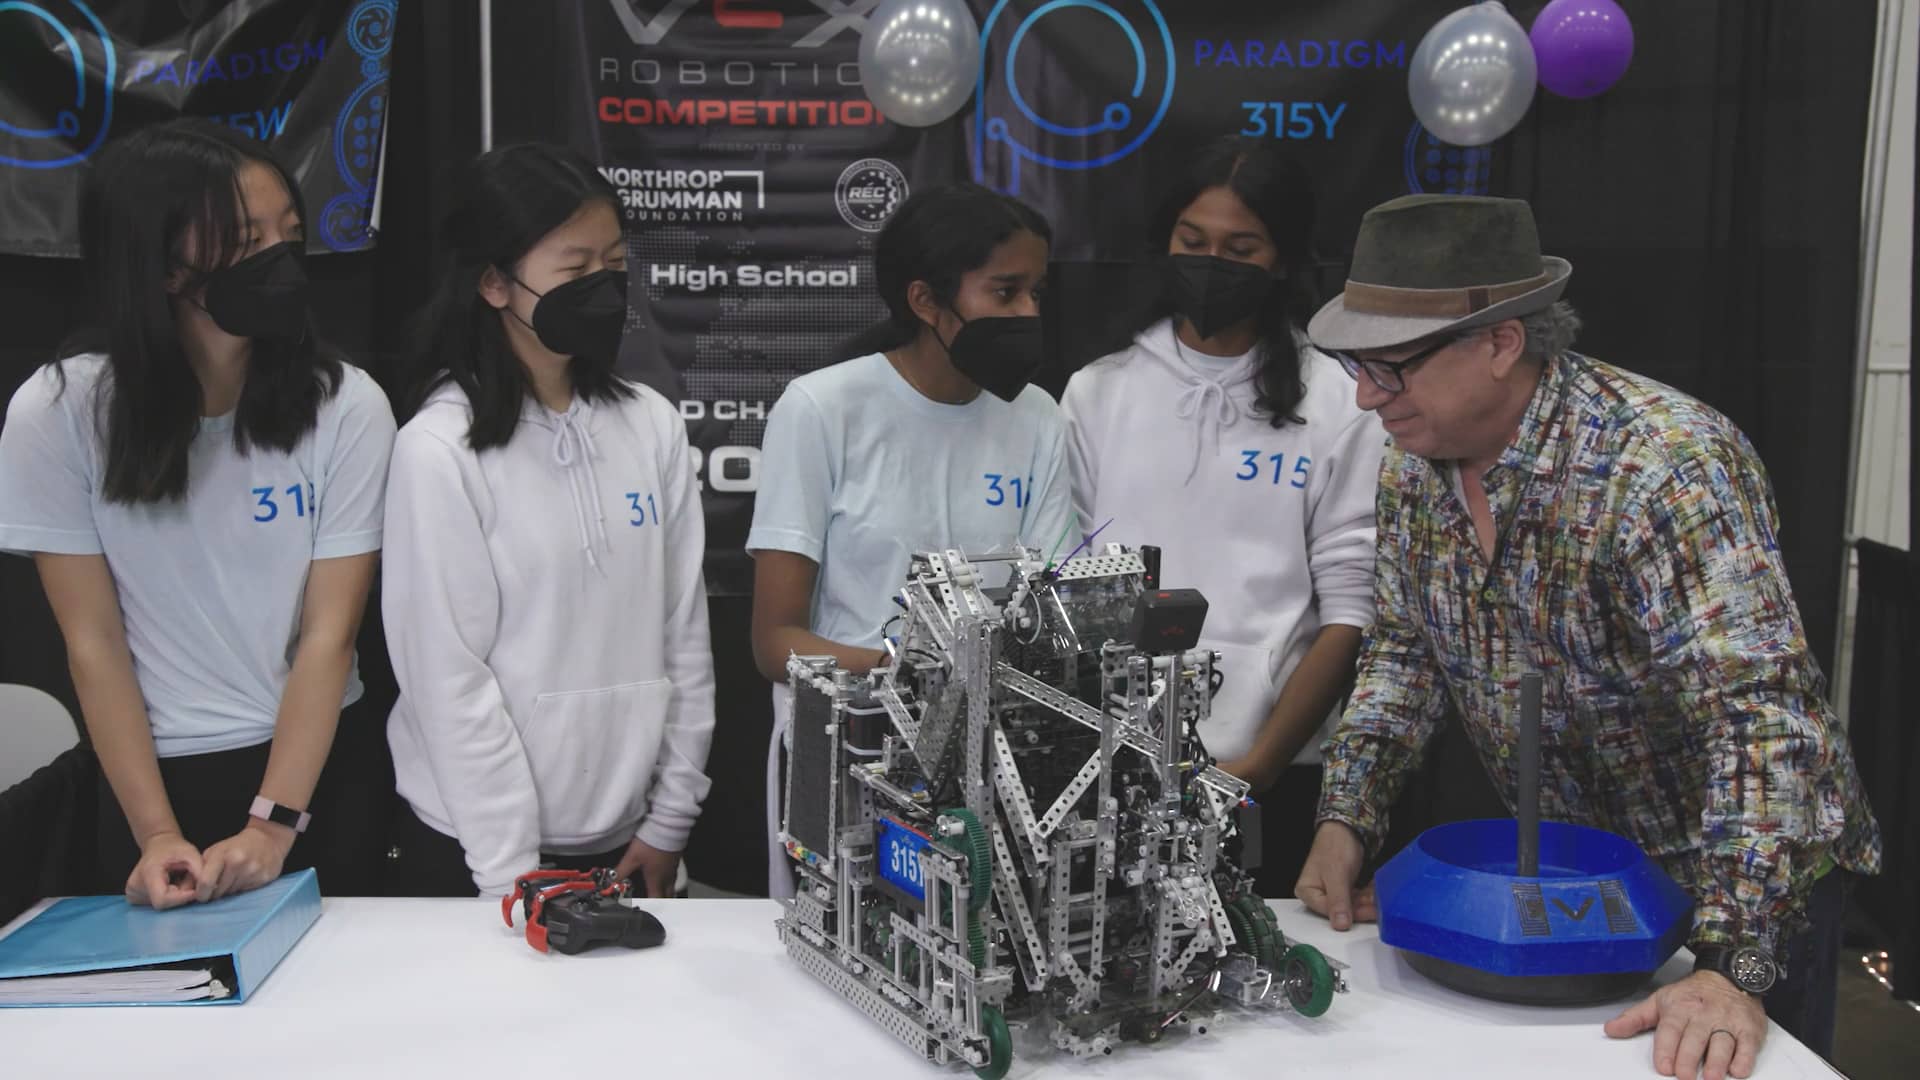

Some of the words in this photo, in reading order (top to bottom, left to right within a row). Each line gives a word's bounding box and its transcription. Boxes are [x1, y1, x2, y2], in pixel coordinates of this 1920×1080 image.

[133, 37, 326, 86] PARADIGM
[1194, 39, 1406, 69] PARADIGM
[600, 57, 863, 86] ROBOTIC
[1240, 101, 1346, 140] 315Y
[617, 189, 742, 209] GRUMMAN
[848, 186, 886, 198] REC
[626, 210, 743, 222] OUNDATION
[651, 264, 728, 291] High
[737, 264, 857, 287] School
[1236, 449, 1311, 489] 315
[252, 482, 315, 522] 31
[983, 473, 1032, 509] 31
